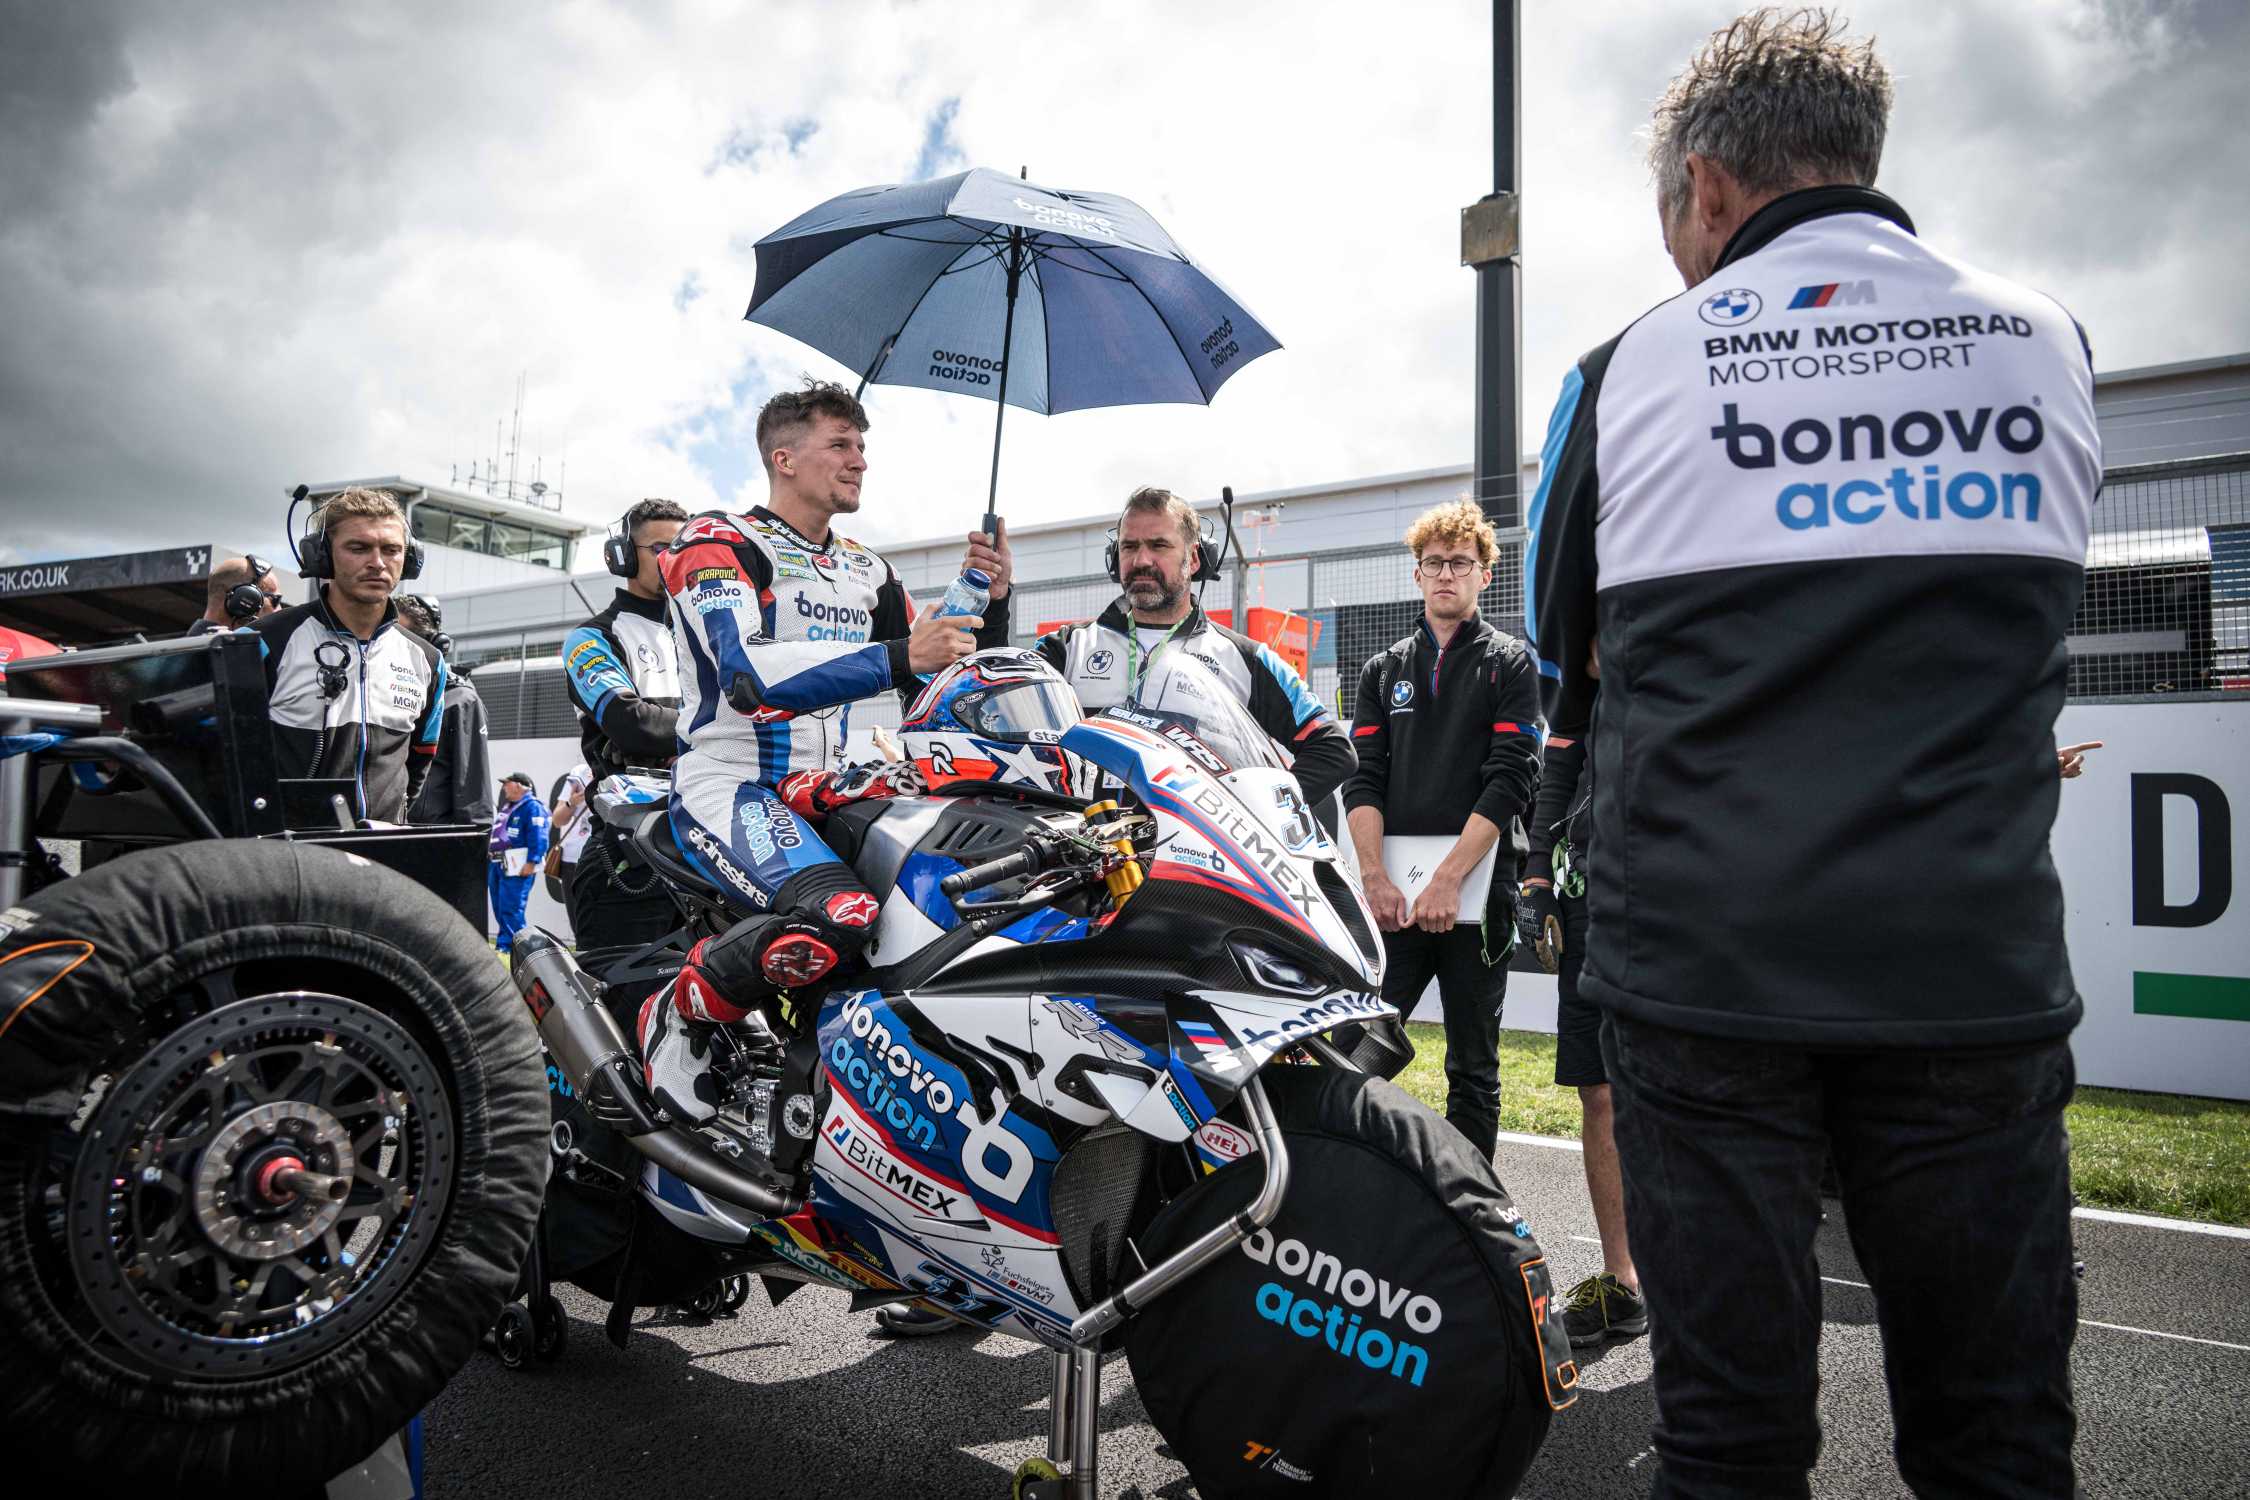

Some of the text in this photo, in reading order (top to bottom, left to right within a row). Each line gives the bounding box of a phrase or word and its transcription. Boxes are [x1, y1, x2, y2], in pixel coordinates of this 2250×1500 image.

[1013, 198, 1111, 227] bonovo
[1704, 315, 2033, 358] BMW MOTORRAD
[1708, 343, 1976, 387] MOTORSPORT
[1711, 402, 2043, 468] bonovo
[1776, 465, 2042, 531] action
[691, 587, 741, 606] bonovo
[698, 599, 742, 615] action
[794, 590, 867, 626] bonovo
[688, 827, 768, 909] alpinestars
[1169, 843, 1207, 859] bonovo
[1174, 854, 1207, 867] action
[1195, 788, 1321, 919] BitMEX
[2131, 773, 2232, 927] D
[840, 991, 953, 1114] bonovo
[831, 1036, 939, 1152] action
[1207, 1131, 1241, 1157] HEL
[848, 1137, 958, 1217] BitMEX
[1255, 1281, 1429, 1387] action
